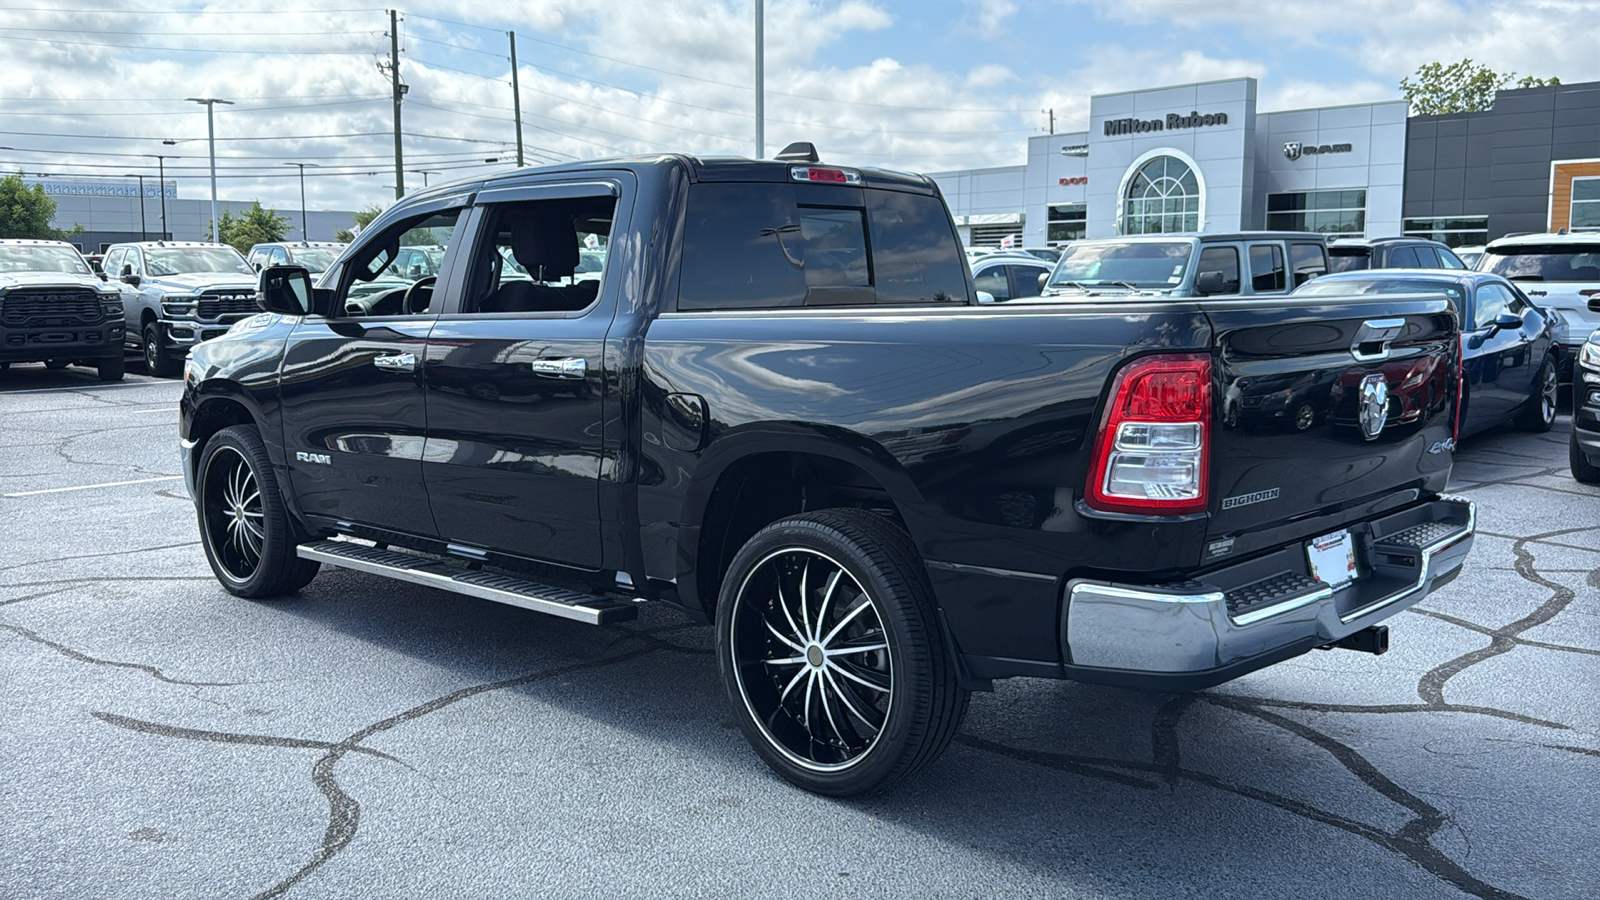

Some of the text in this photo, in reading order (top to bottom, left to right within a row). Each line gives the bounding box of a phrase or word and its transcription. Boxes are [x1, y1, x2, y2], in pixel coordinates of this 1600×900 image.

[1103, 110, 1228, 136] Milton Ruben
[1303, 143, 1352, 156] RAM
[1527, 289, 1548, 297] Jeep
[296, 451, 331, 465] RAM
[1222, 487, 1280, 510] BIGHORN
